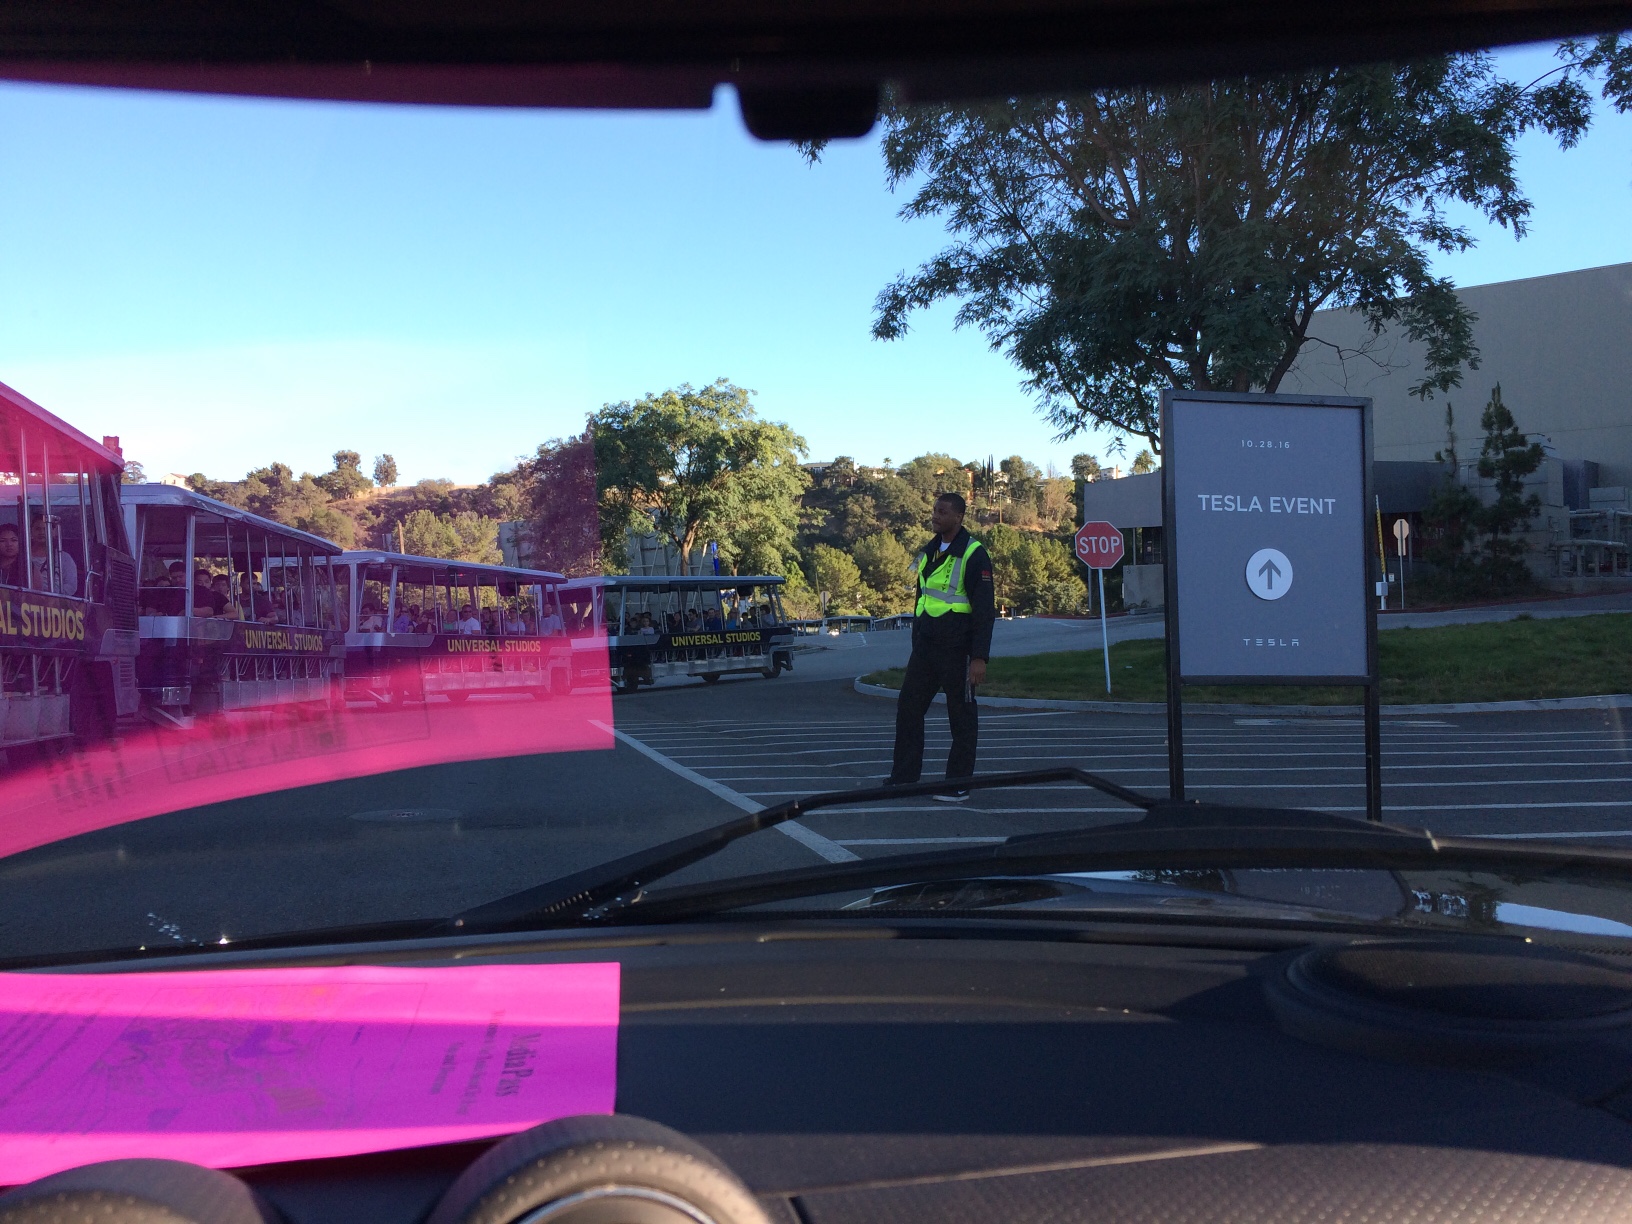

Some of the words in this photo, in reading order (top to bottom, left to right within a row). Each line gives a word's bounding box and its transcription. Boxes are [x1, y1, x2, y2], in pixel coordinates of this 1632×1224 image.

[1241, 439, 1291, 449] 10.28.16
[1197, 494, 1263, 513] TESLA
[1269, 496, 1336, 515] EVENT
[1079, 536, 1121, 555] STOP
[21, 602, 85, 641] STUDIOS
[245, 629, 293, 650] UNIVERSAL
[294, 633, 323, 652] STUDIOS
[447, 639, 503, 653] UNIVERSAL
[504, 640, 541, 653] STUDIOS
[671, 633, 724, 647] UNIVERSAL
[725, 631, 761, 643] STUDIOS
[1242, 638, 1300, 647] TESLA
